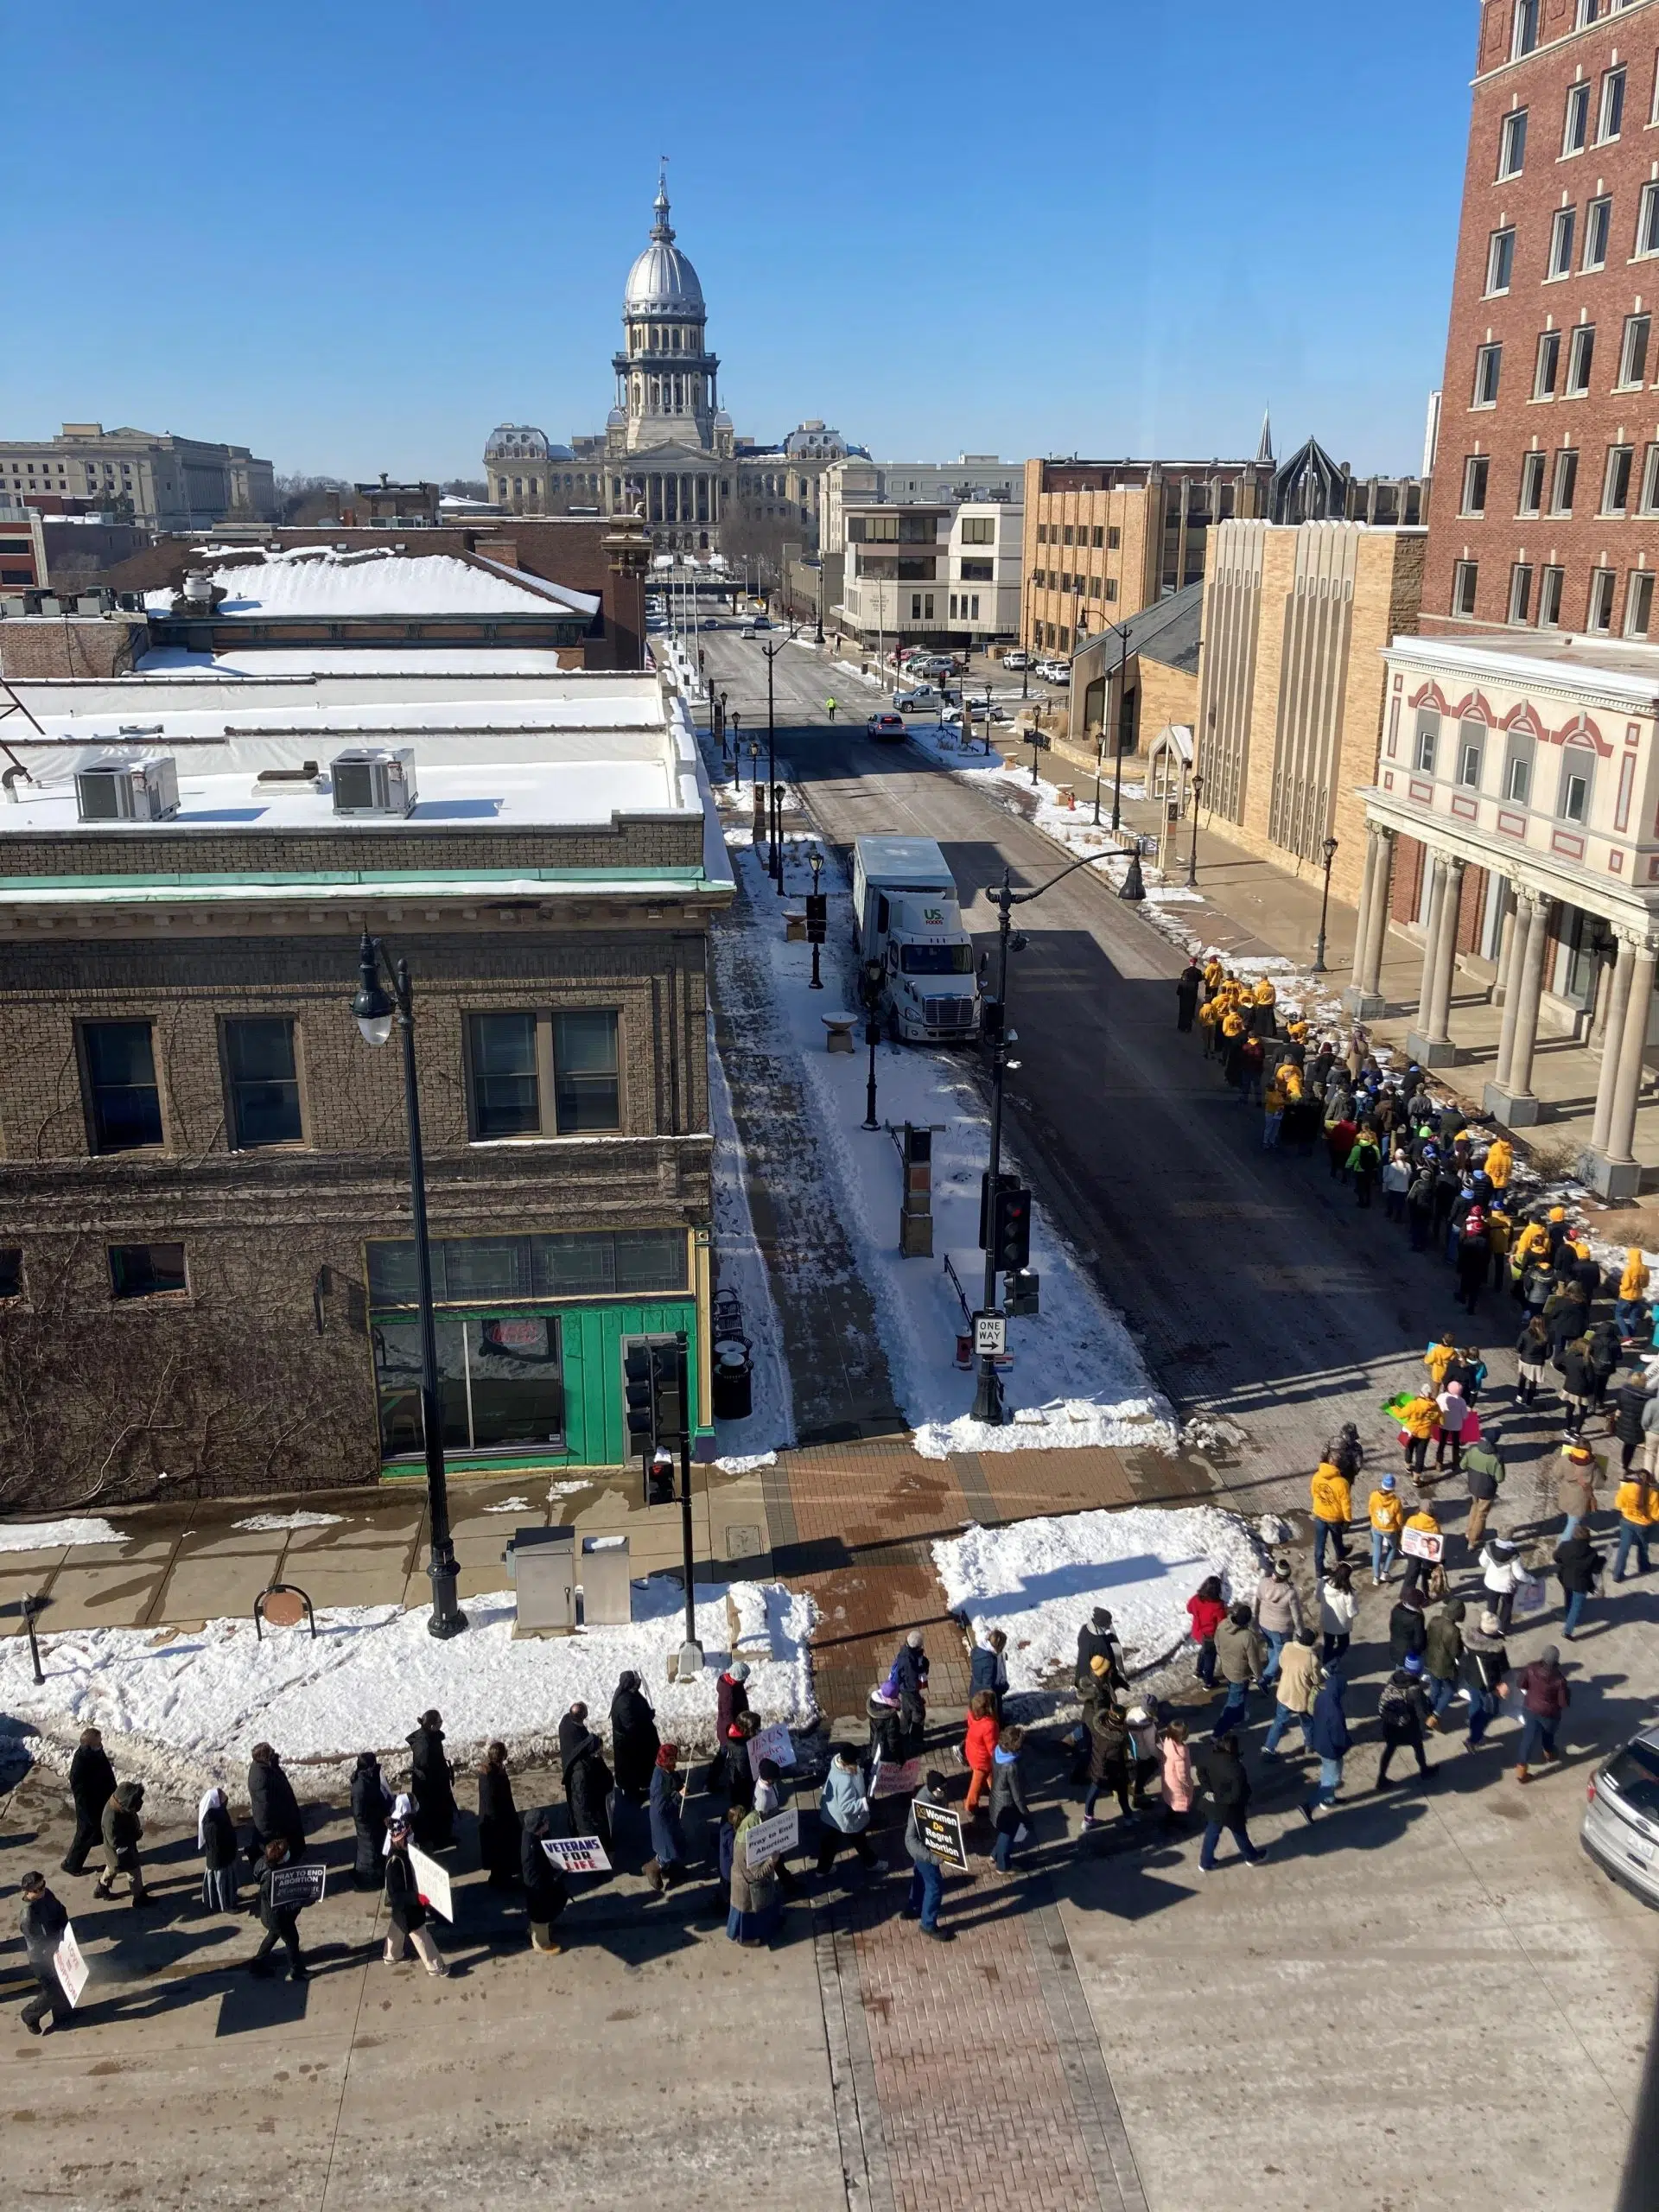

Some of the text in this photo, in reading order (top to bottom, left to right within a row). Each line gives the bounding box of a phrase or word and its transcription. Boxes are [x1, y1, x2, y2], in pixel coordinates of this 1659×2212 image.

[750, 1728, 783, 1756] JESUS
[925, 1808, 957, 1827] Women
[933, 1821, 944, 1832] Do
[749, 1836, 766, 1849] Pray
[779, 1822, 793, 1834] End
[925, 1827, 953, 1844] Regret
[544, 1839, 601, 1853] VETERANS
[756, 1835, 790, 1855] Abortion
[925, 1837, 960, 1857] Abortion
[563, 1851, 592, 1861] FOR
[564, 1859, 599, 1872] LIFE
[275, 1872, 295, 1882] PRAY
[279, 1876, 319, 1886] ABORTION
